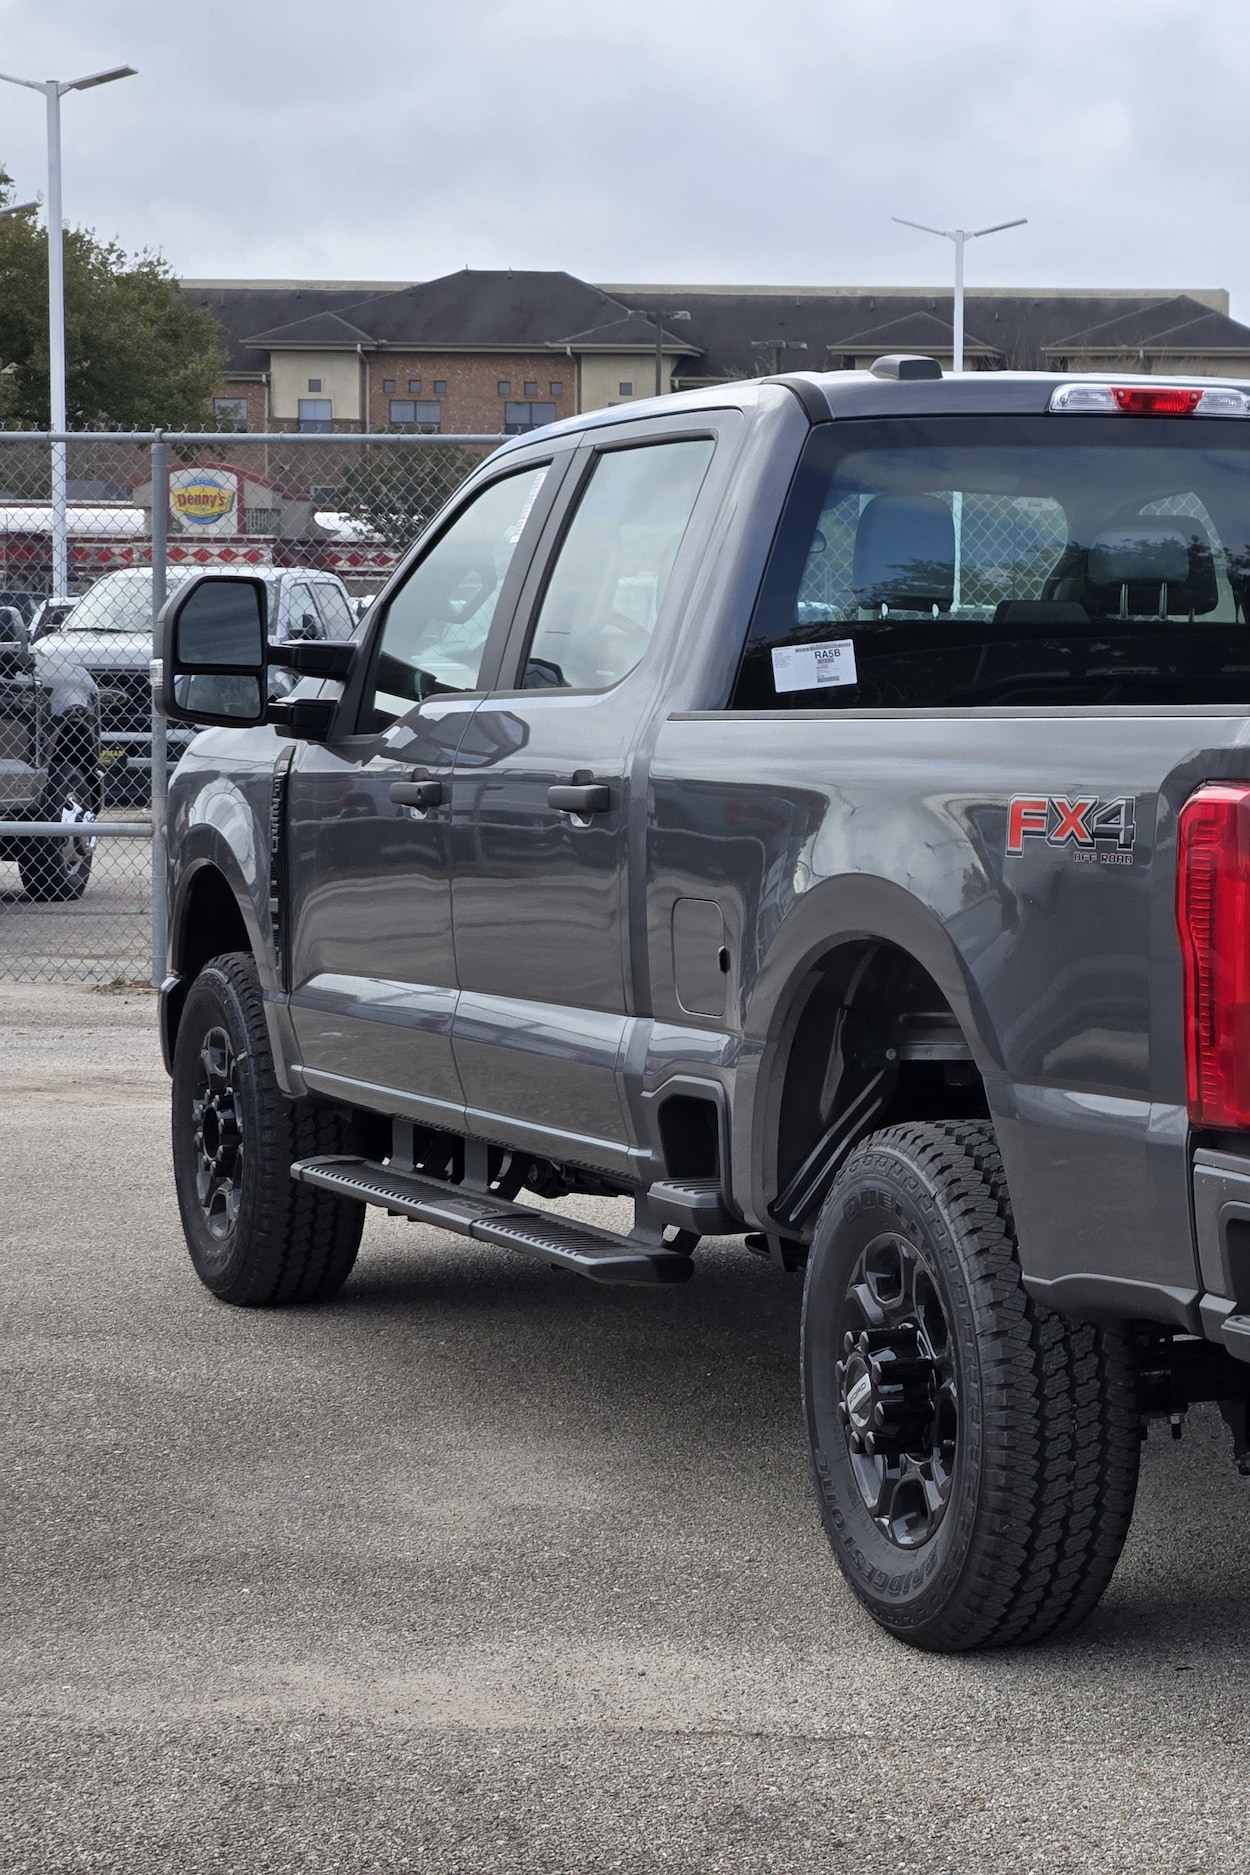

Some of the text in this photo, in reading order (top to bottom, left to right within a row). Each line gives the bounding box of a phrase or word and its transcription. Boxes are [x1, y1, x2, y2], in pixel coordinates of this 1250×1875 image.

[176, 491, 226, 508] Denny's
[814, 648, 841, 660] RA5B
[1005, 792, 1137, 859] FX4
[1073, 851, 1134, 865] OFF ROAD
